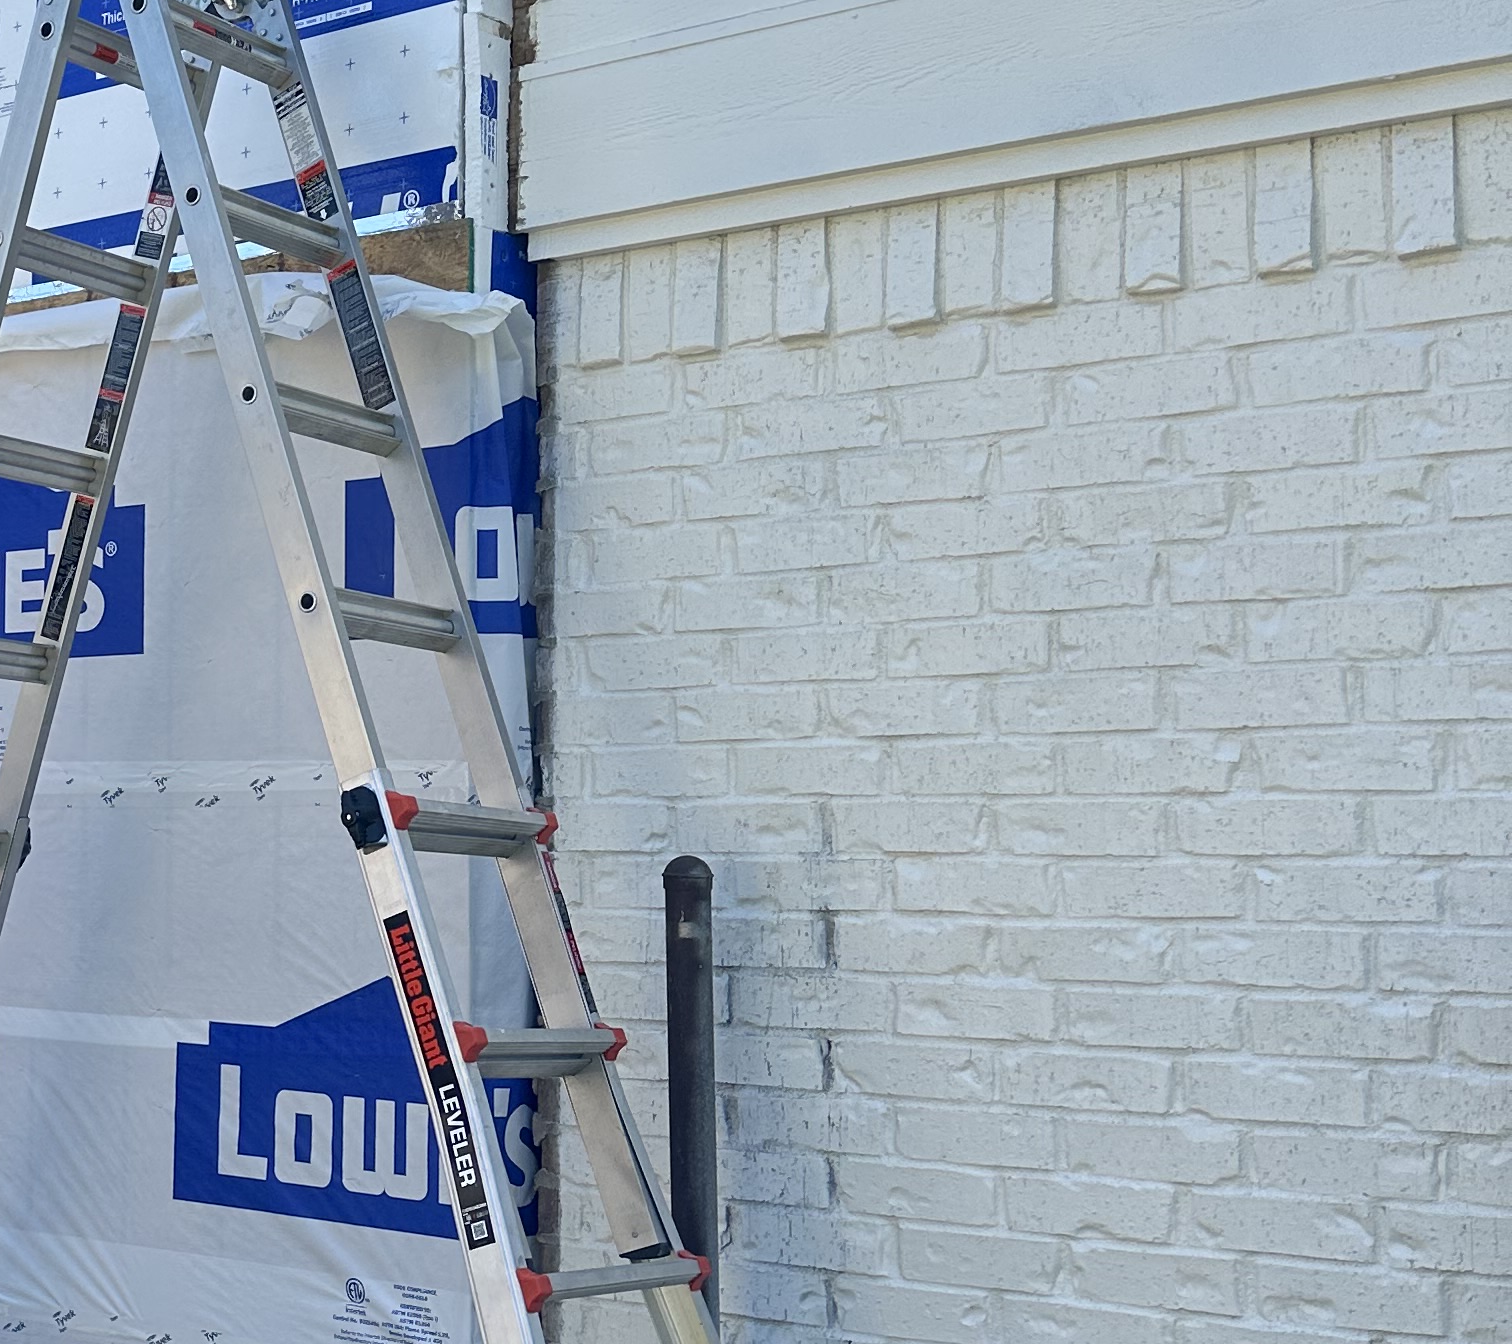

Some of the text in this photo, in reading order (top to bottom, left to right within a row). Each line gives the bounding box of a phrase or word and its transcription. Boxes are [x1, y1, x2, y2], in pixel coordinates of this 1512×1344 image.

[389, 922, 477, 1188] Little Giant LEVELER
